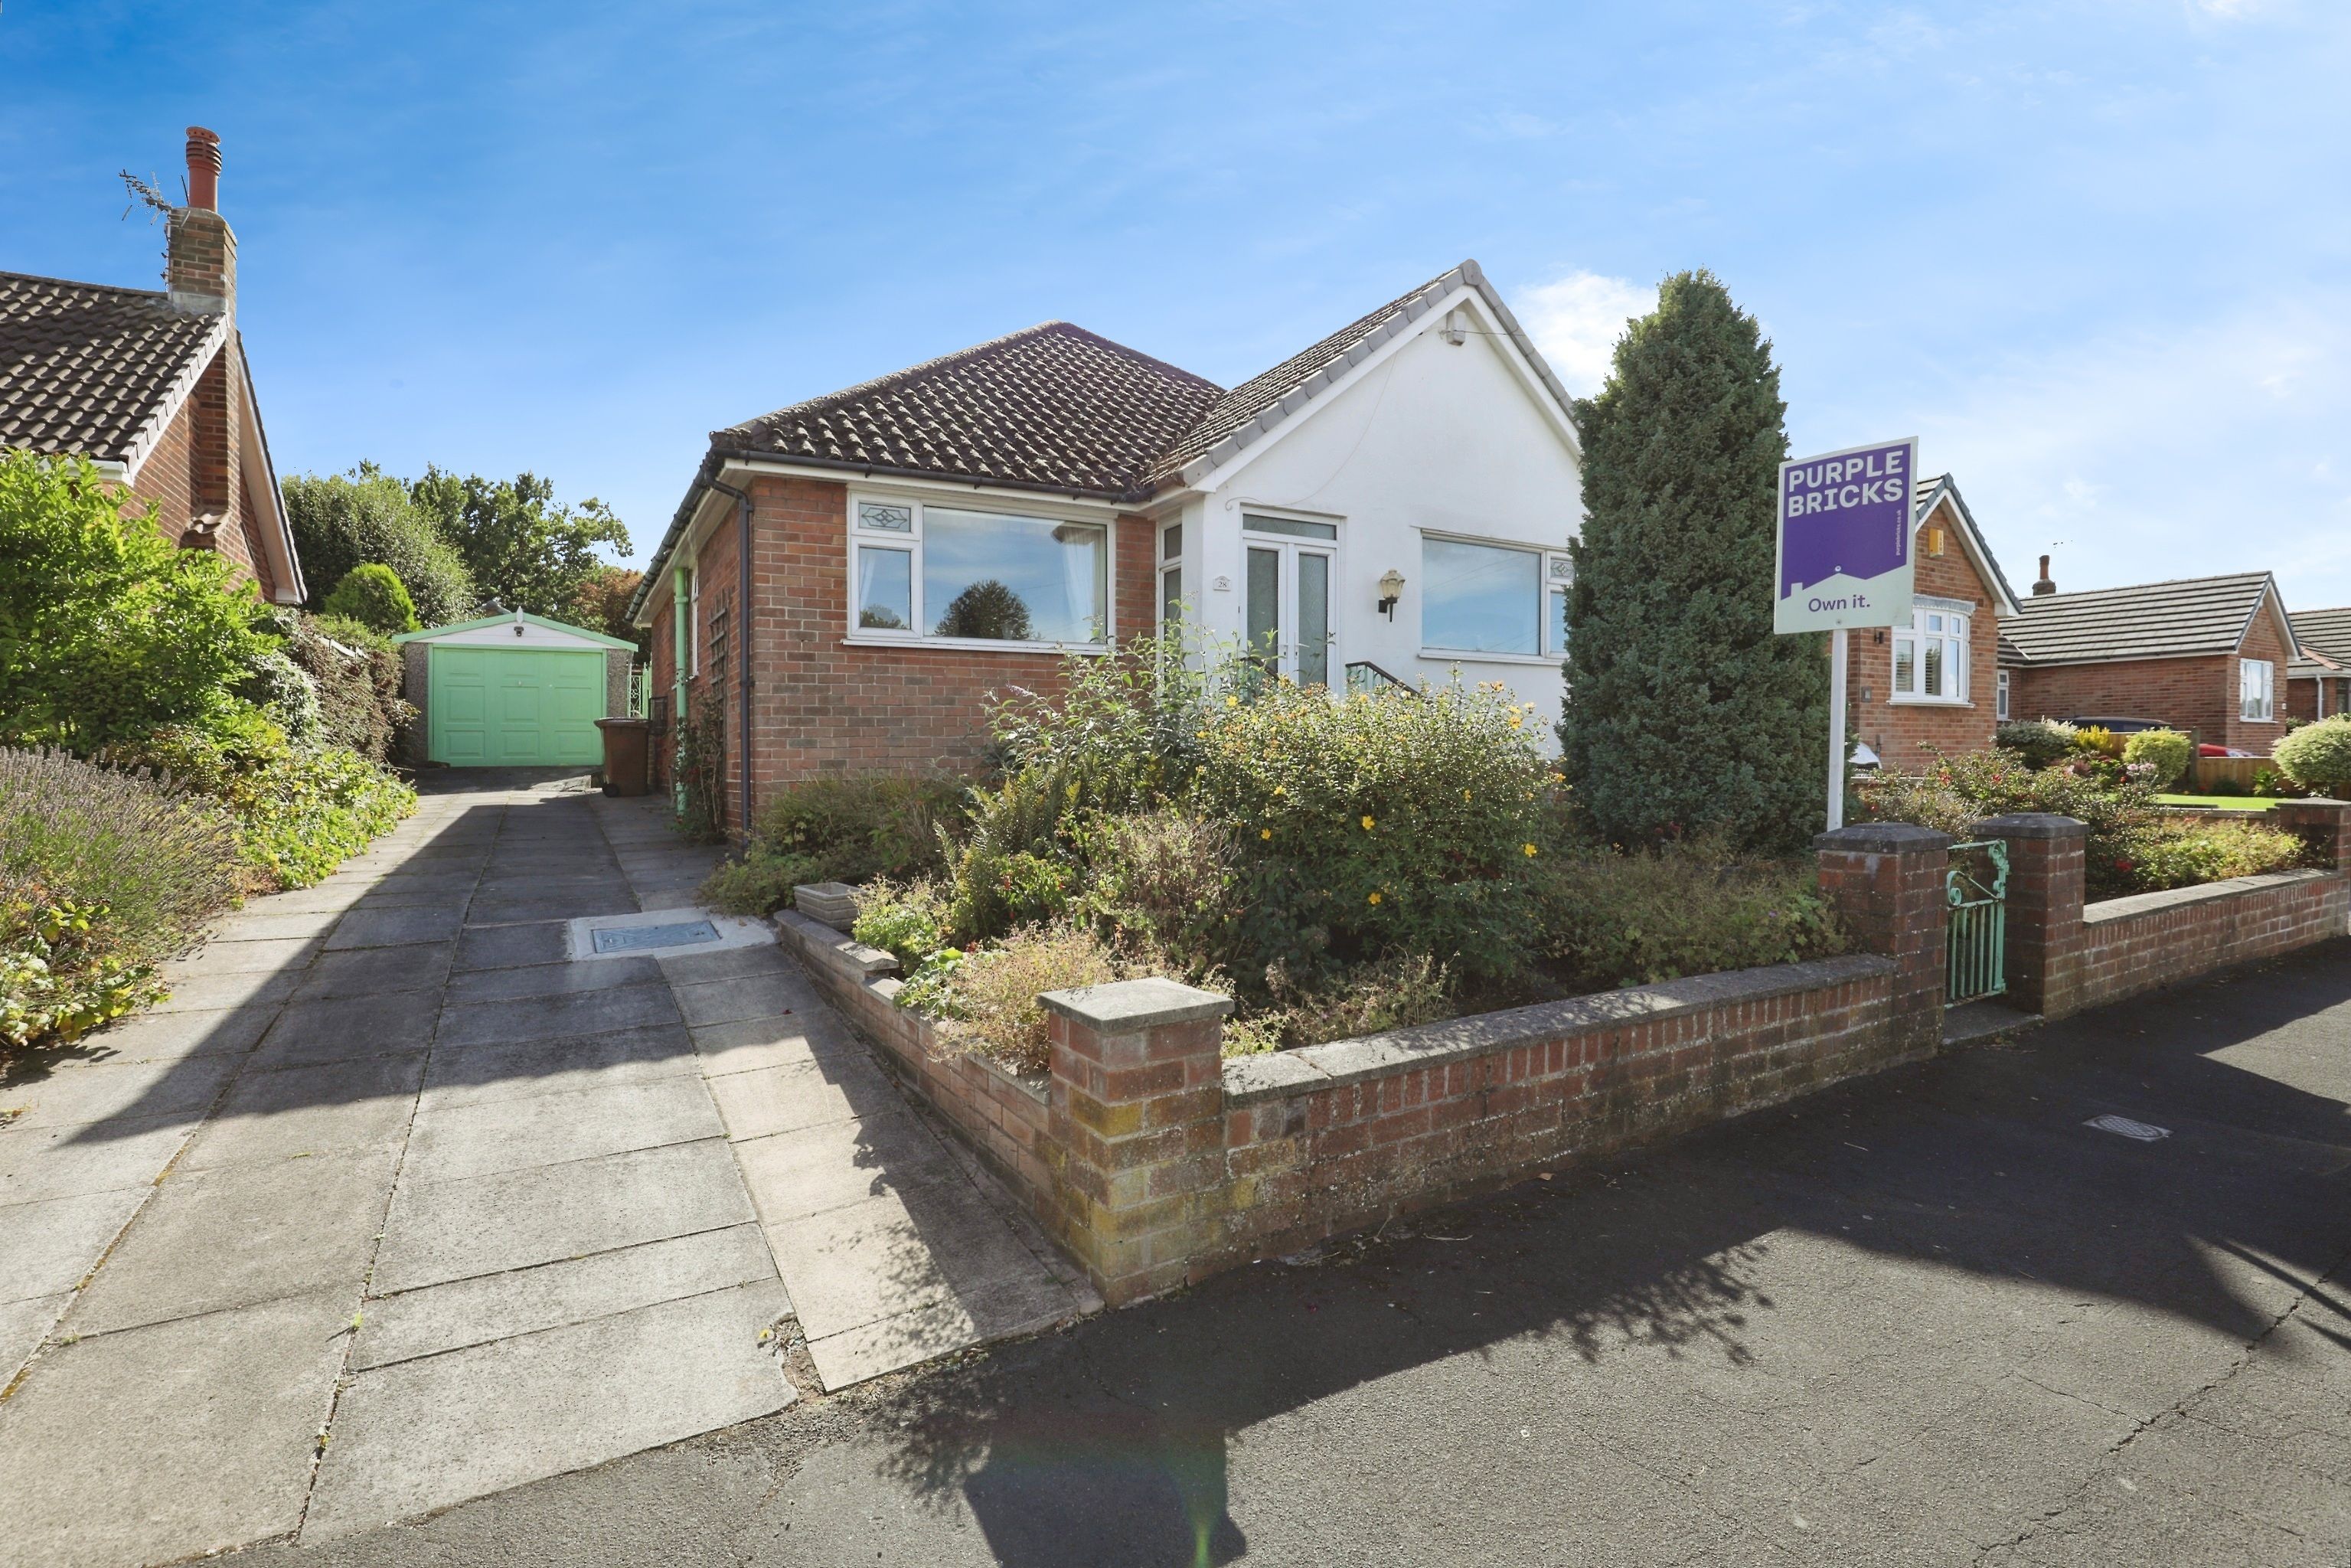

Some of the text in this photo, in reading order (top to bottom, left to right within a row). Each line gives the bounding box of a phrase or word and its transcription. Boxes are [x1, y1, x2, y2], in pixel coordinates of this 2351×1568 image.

[1788, 450, 1903, 492] PURPLE
[1788, 478, 1903, 518] BRICKS
[1808, 594, 1870, 612] Own it.
